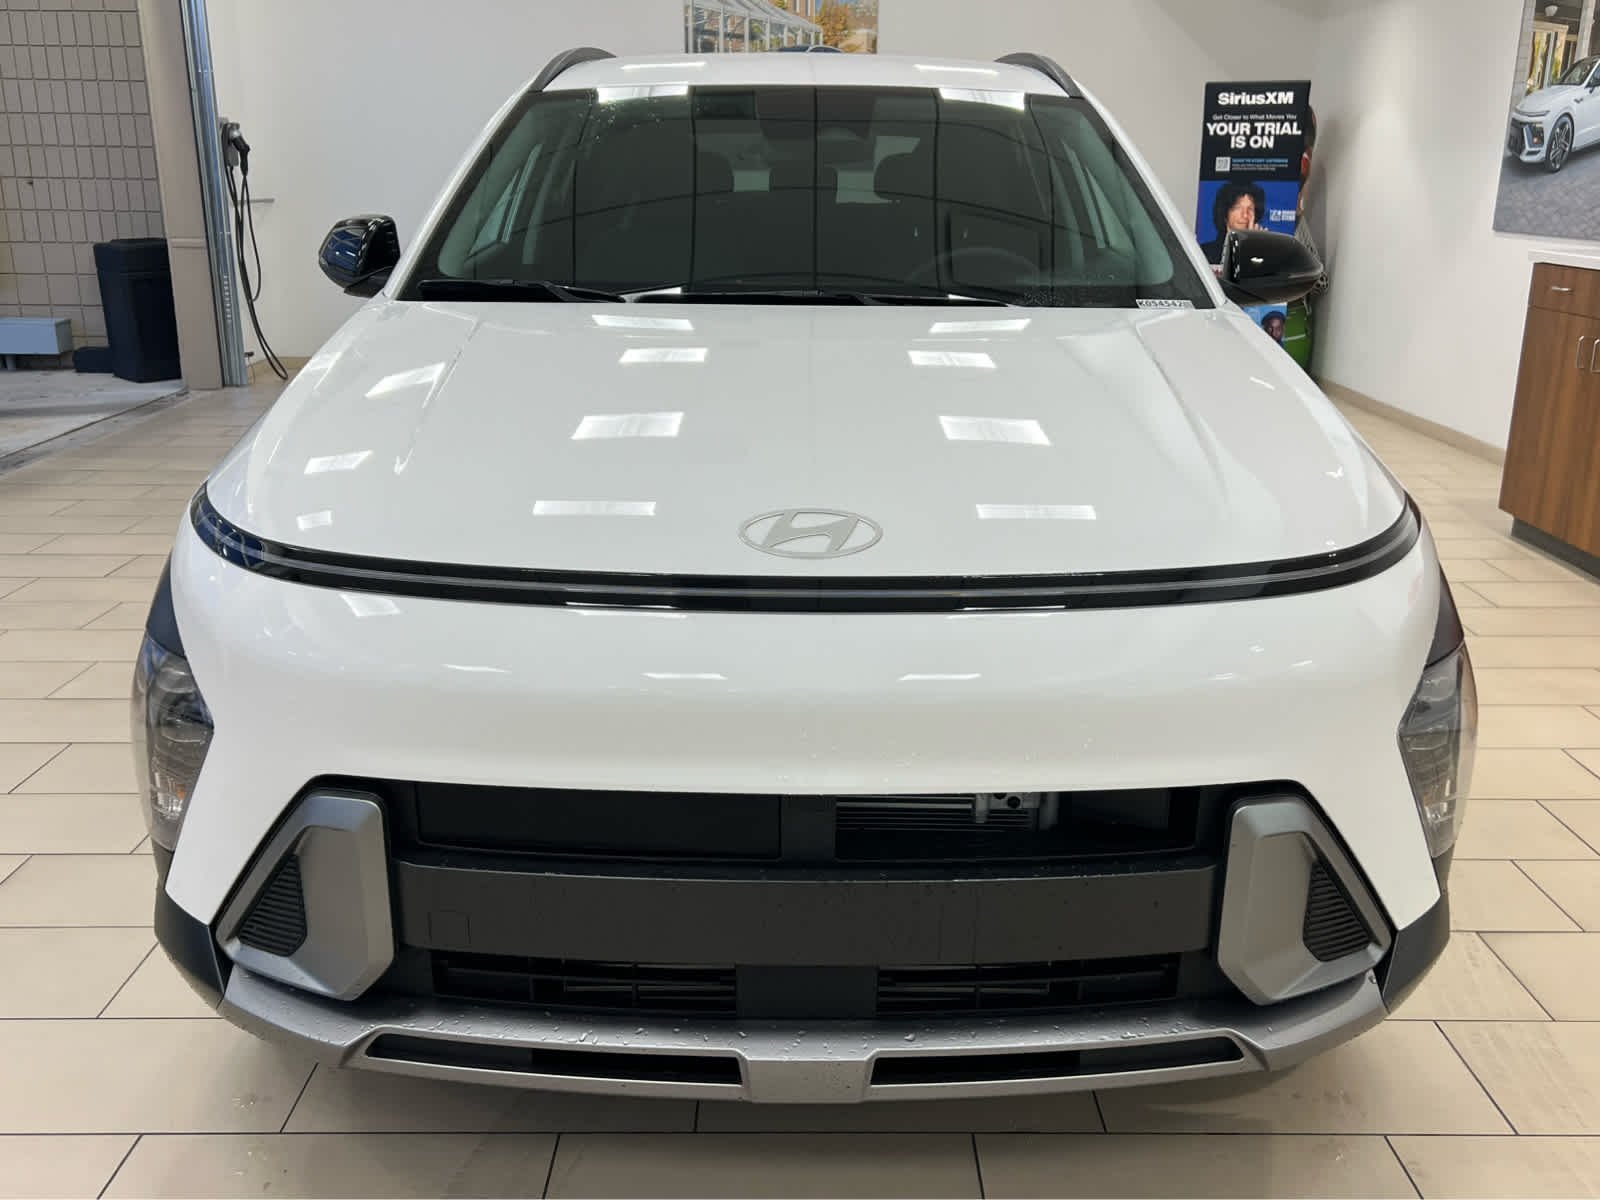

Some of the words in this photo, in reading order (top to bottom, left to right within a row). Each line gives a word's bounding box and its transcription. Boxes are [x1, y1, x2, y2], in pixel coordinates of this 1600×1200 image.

[1218, 91, 1294, 105] SiriusXM
[1206, 122, 1250, 136] YOUR
[1254, 121, 1302, 135] TRIAL
[1230, 135, 1246, 149] IS
[1249, 135, 1275, 149] ON
